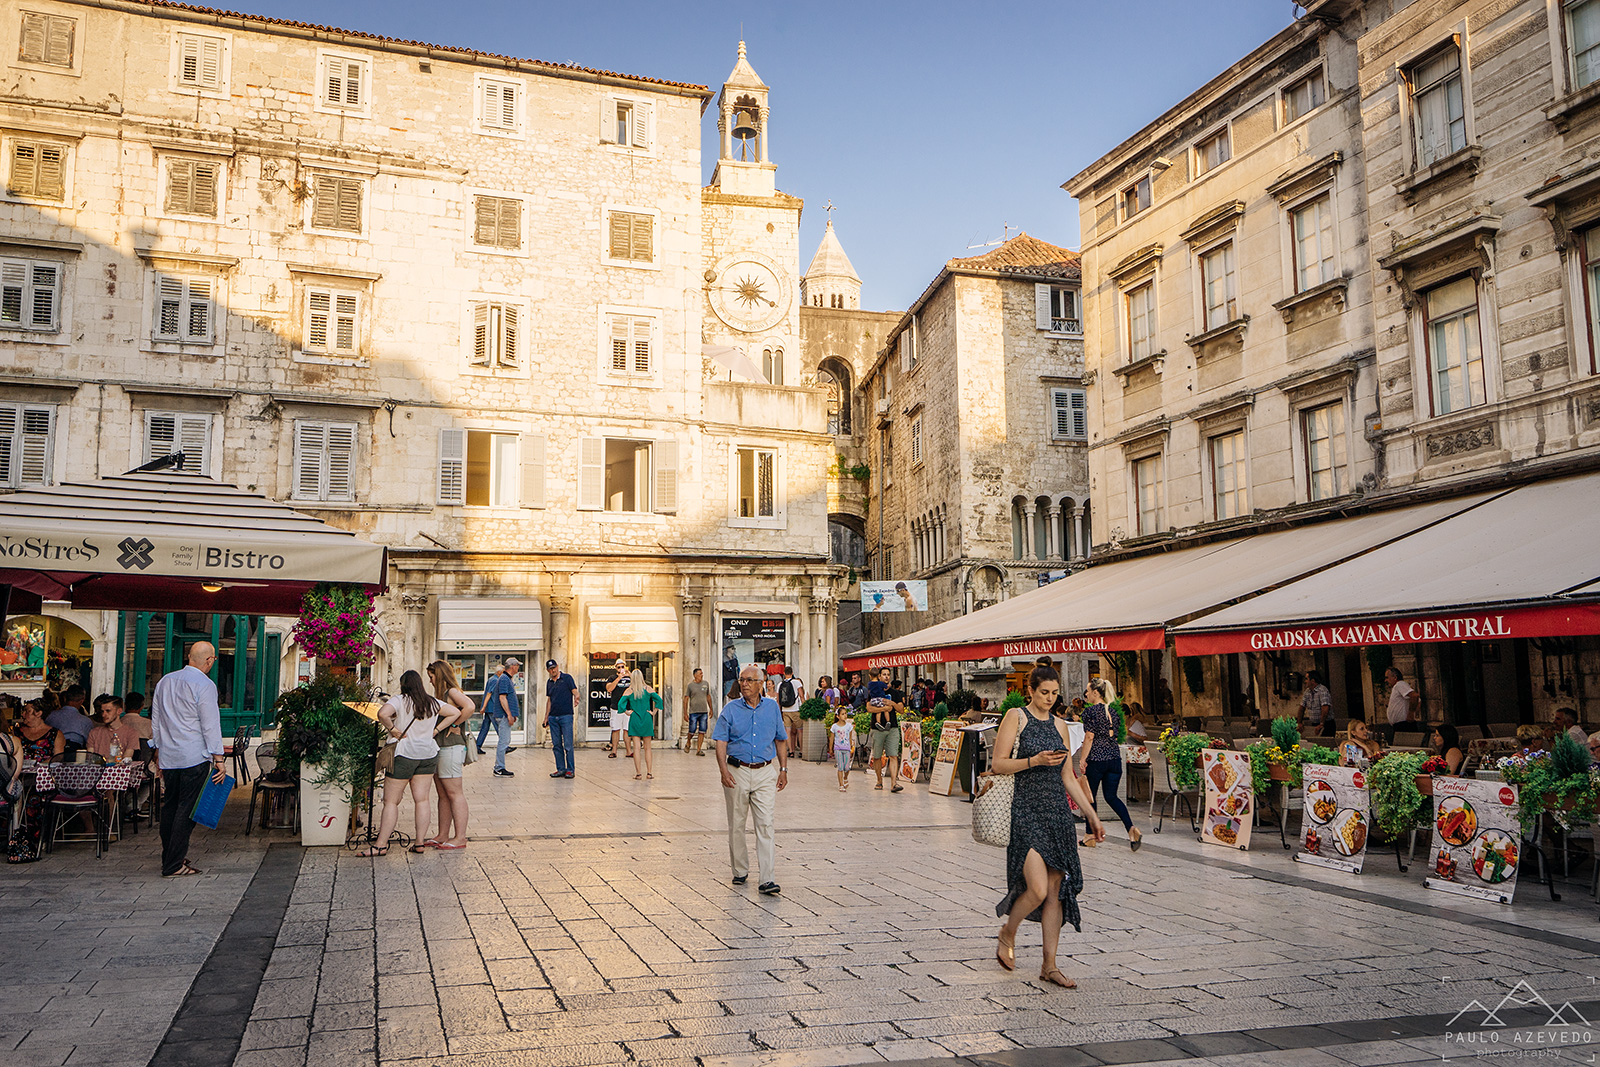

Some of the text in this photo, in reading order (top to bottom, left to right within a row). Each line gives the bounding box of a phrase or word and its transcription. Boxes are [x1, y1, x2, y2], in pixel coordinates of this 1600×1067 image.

[171, 552, 194, 560] Family
[205, 547, 285, 570] Bistro
[1250, 615, 1511, 649] GRADSKA KAVANA CENTRAL
[1003, 637, 1107, 655] RESTAURANT CENTRAL
[868, 651, 943, 668] GRADSKA KAVANA CENTRAL
[590, 691, 611, 699] ONL
[1304, 766, 1331, 777] Central
[1435, 780, 1470, 792] Central
